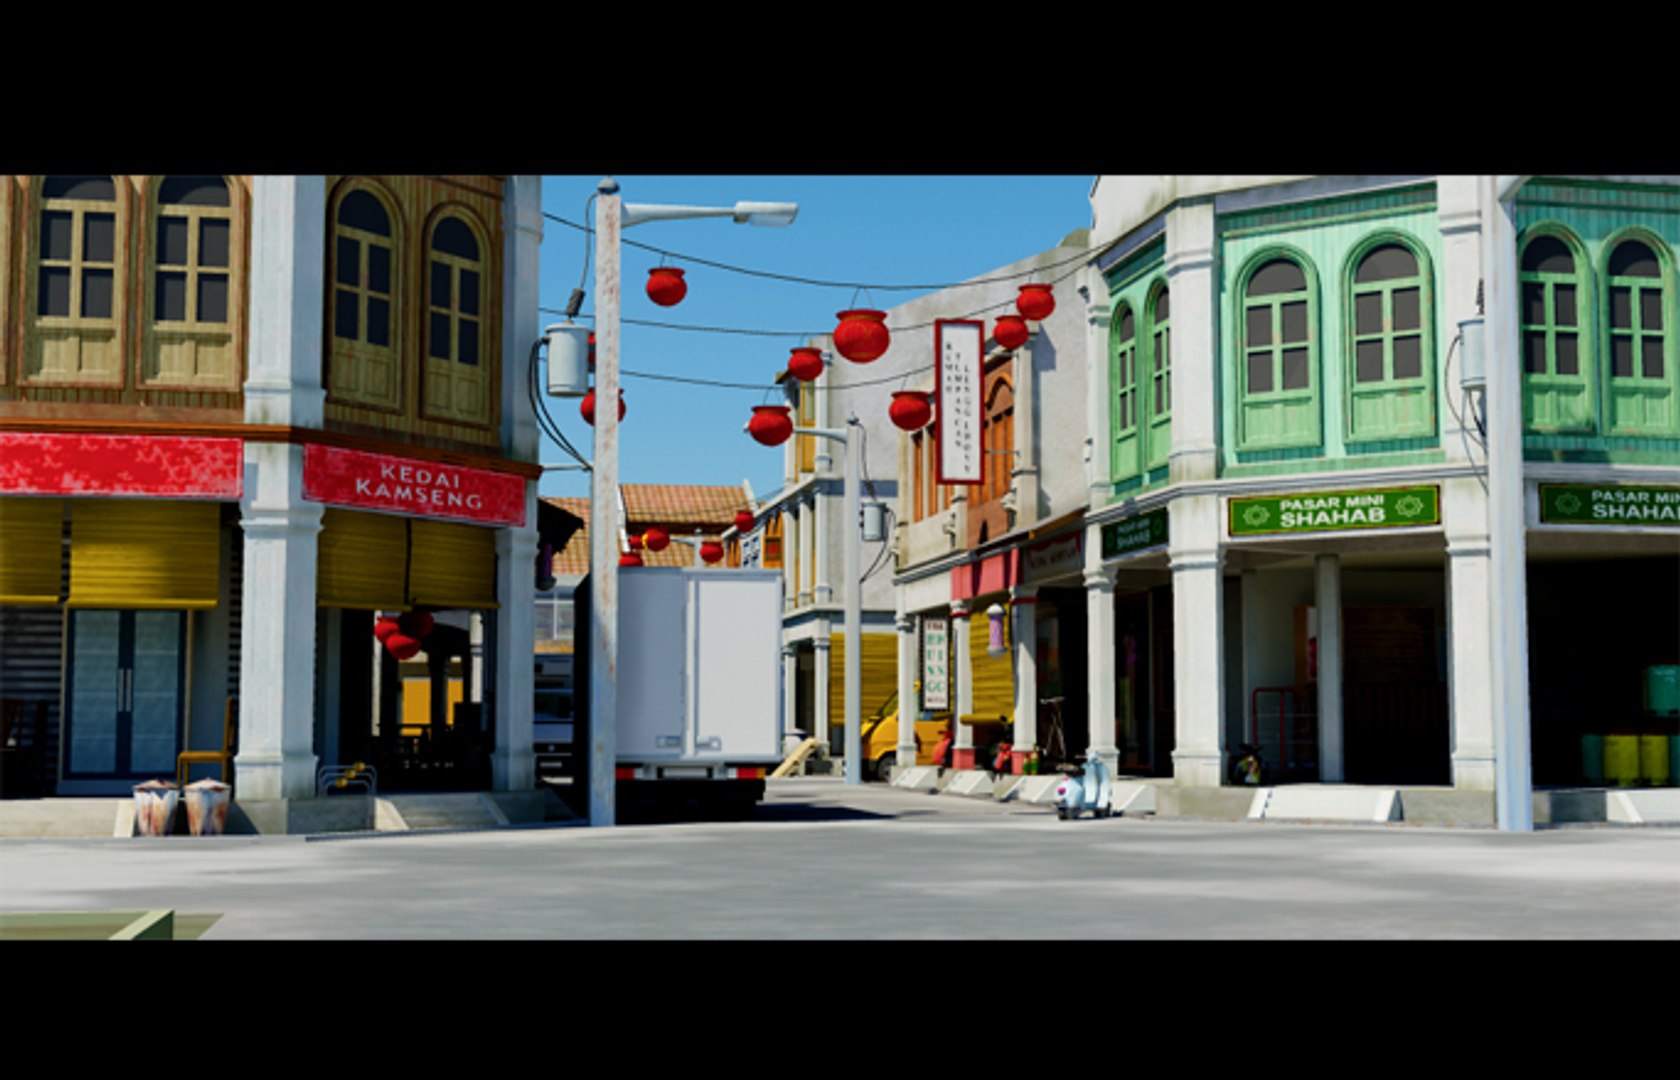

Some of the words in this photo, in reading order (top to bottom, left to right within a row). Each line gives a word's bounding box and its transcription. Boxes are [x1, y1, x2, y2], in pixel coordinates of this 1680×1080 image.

[381, 463, 460, 488] KEDAI
[356, 478, 482, 509] KAMSENG
[1280, 497, 1340, 511] PASAR
[1345, 494, 1384, 508] MINI
[1591, 489, 1650, 503] PASAR
[1280, 507, 1386, 528] SHAHAB
[1591, 503, 1680, 519] SHAHA
